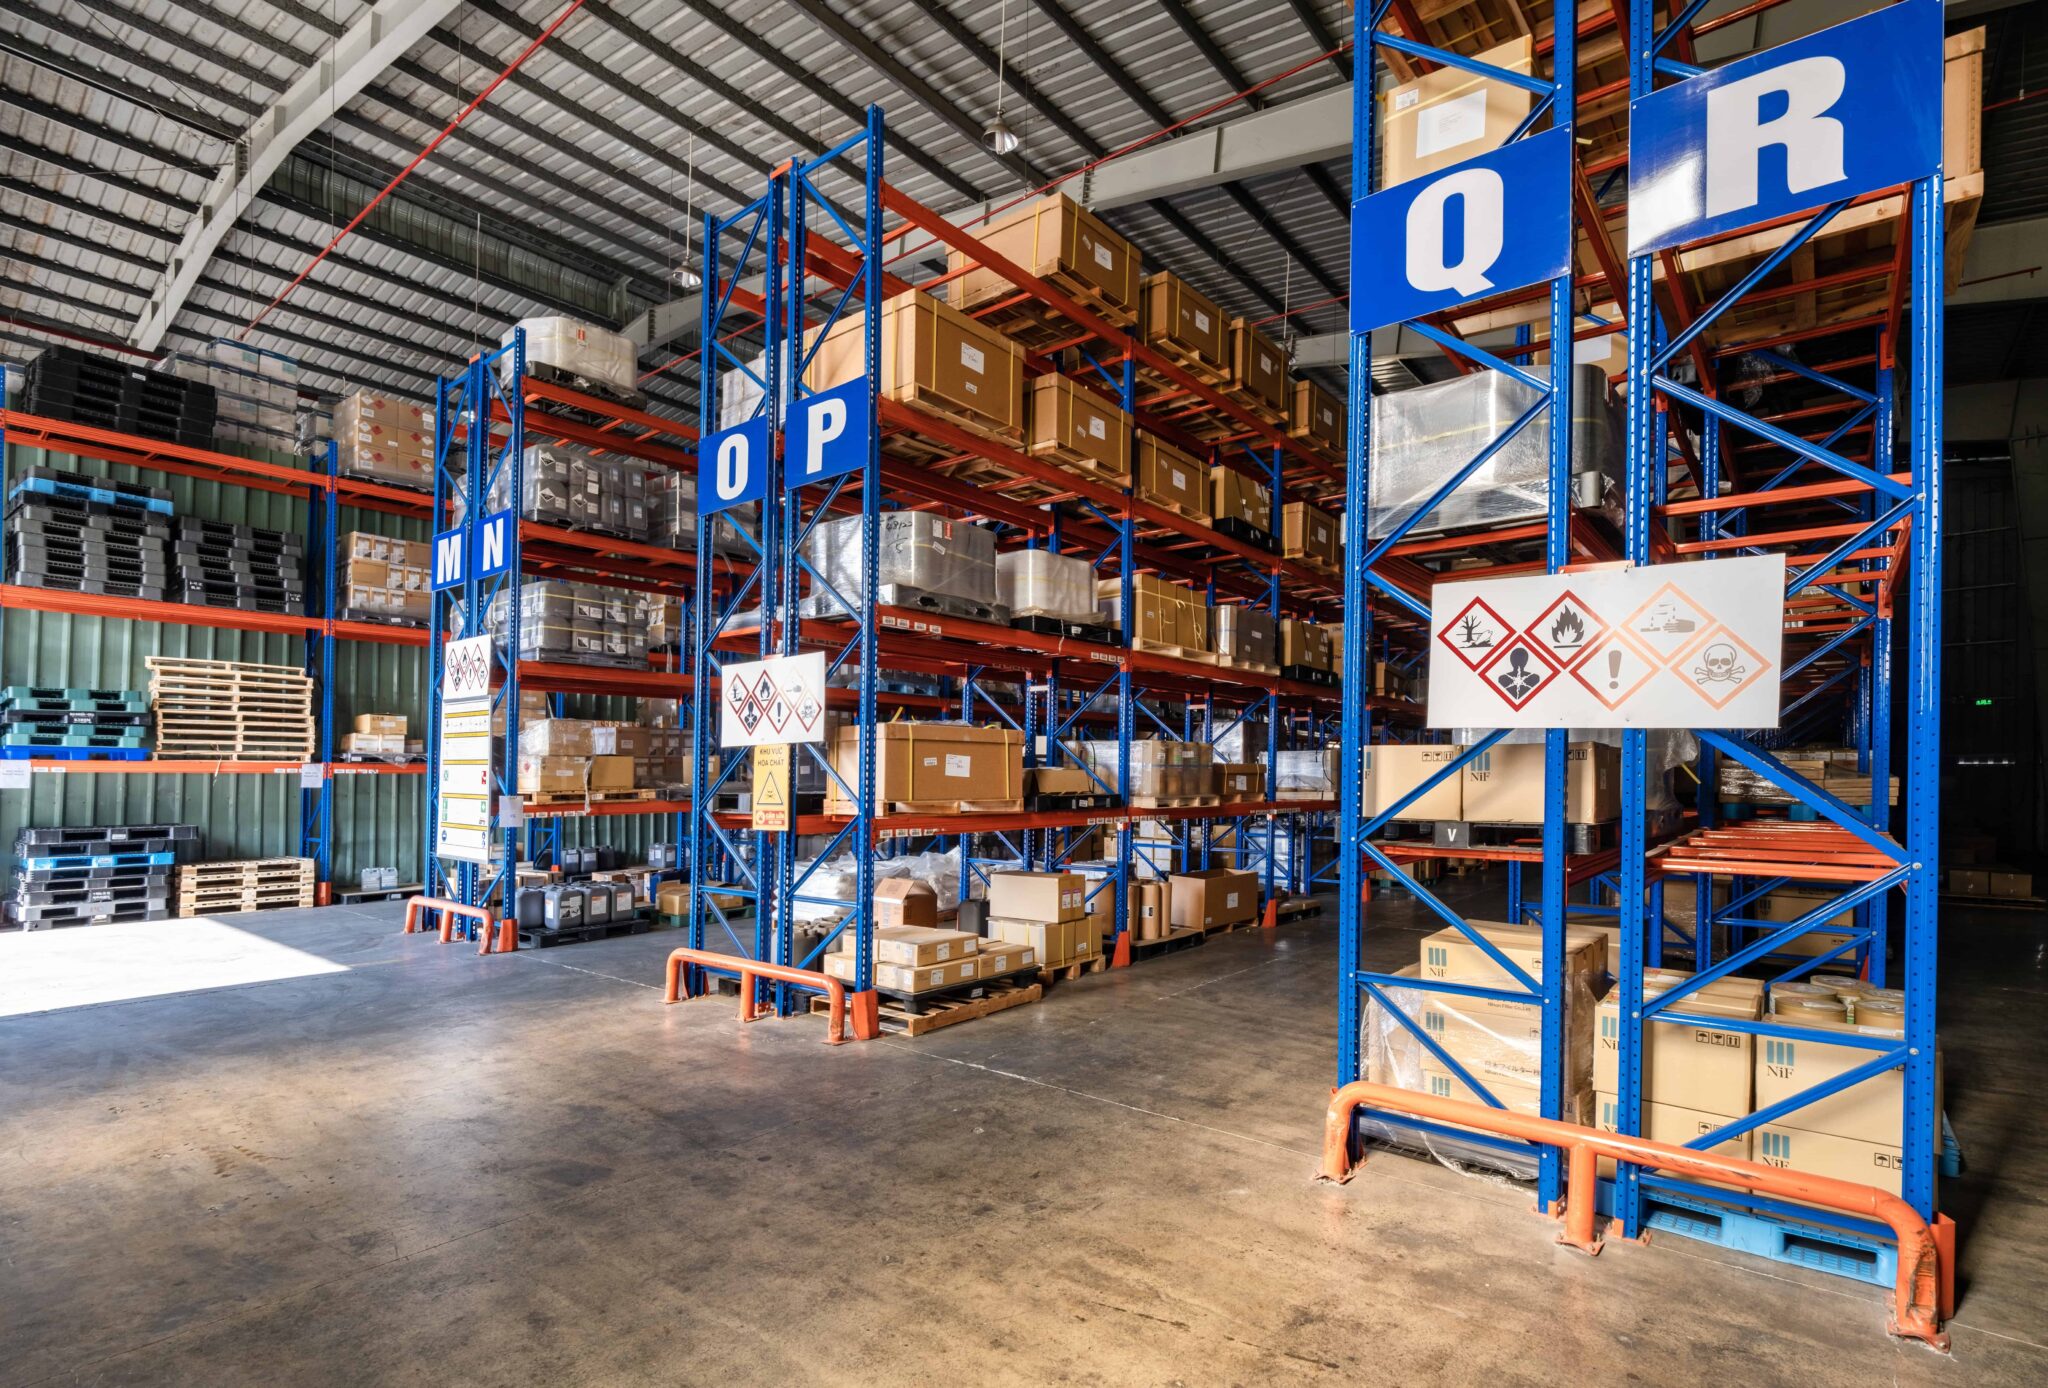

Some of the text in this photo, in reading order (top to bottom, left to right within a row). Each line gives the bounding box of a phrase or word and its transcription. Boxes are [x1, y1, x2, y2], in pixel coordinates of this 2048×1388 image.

[1706, 57, 1847, 218] R
[1406, 169, 1503, 296] Q
[807, 399, 846, 474] P
[717, 434, 748, 500] O
[437, 534, 461, 584] M
[483, 518, 503, 571] N
[1470, 772, 1491, 782] NiF
[1447, 828, 1457, 842] V
[1429, 967, 1447, 978] NiF
[1602, 1038, 1619, 1050] Ni
[1767, 1065, 1794, 1079] NiF
